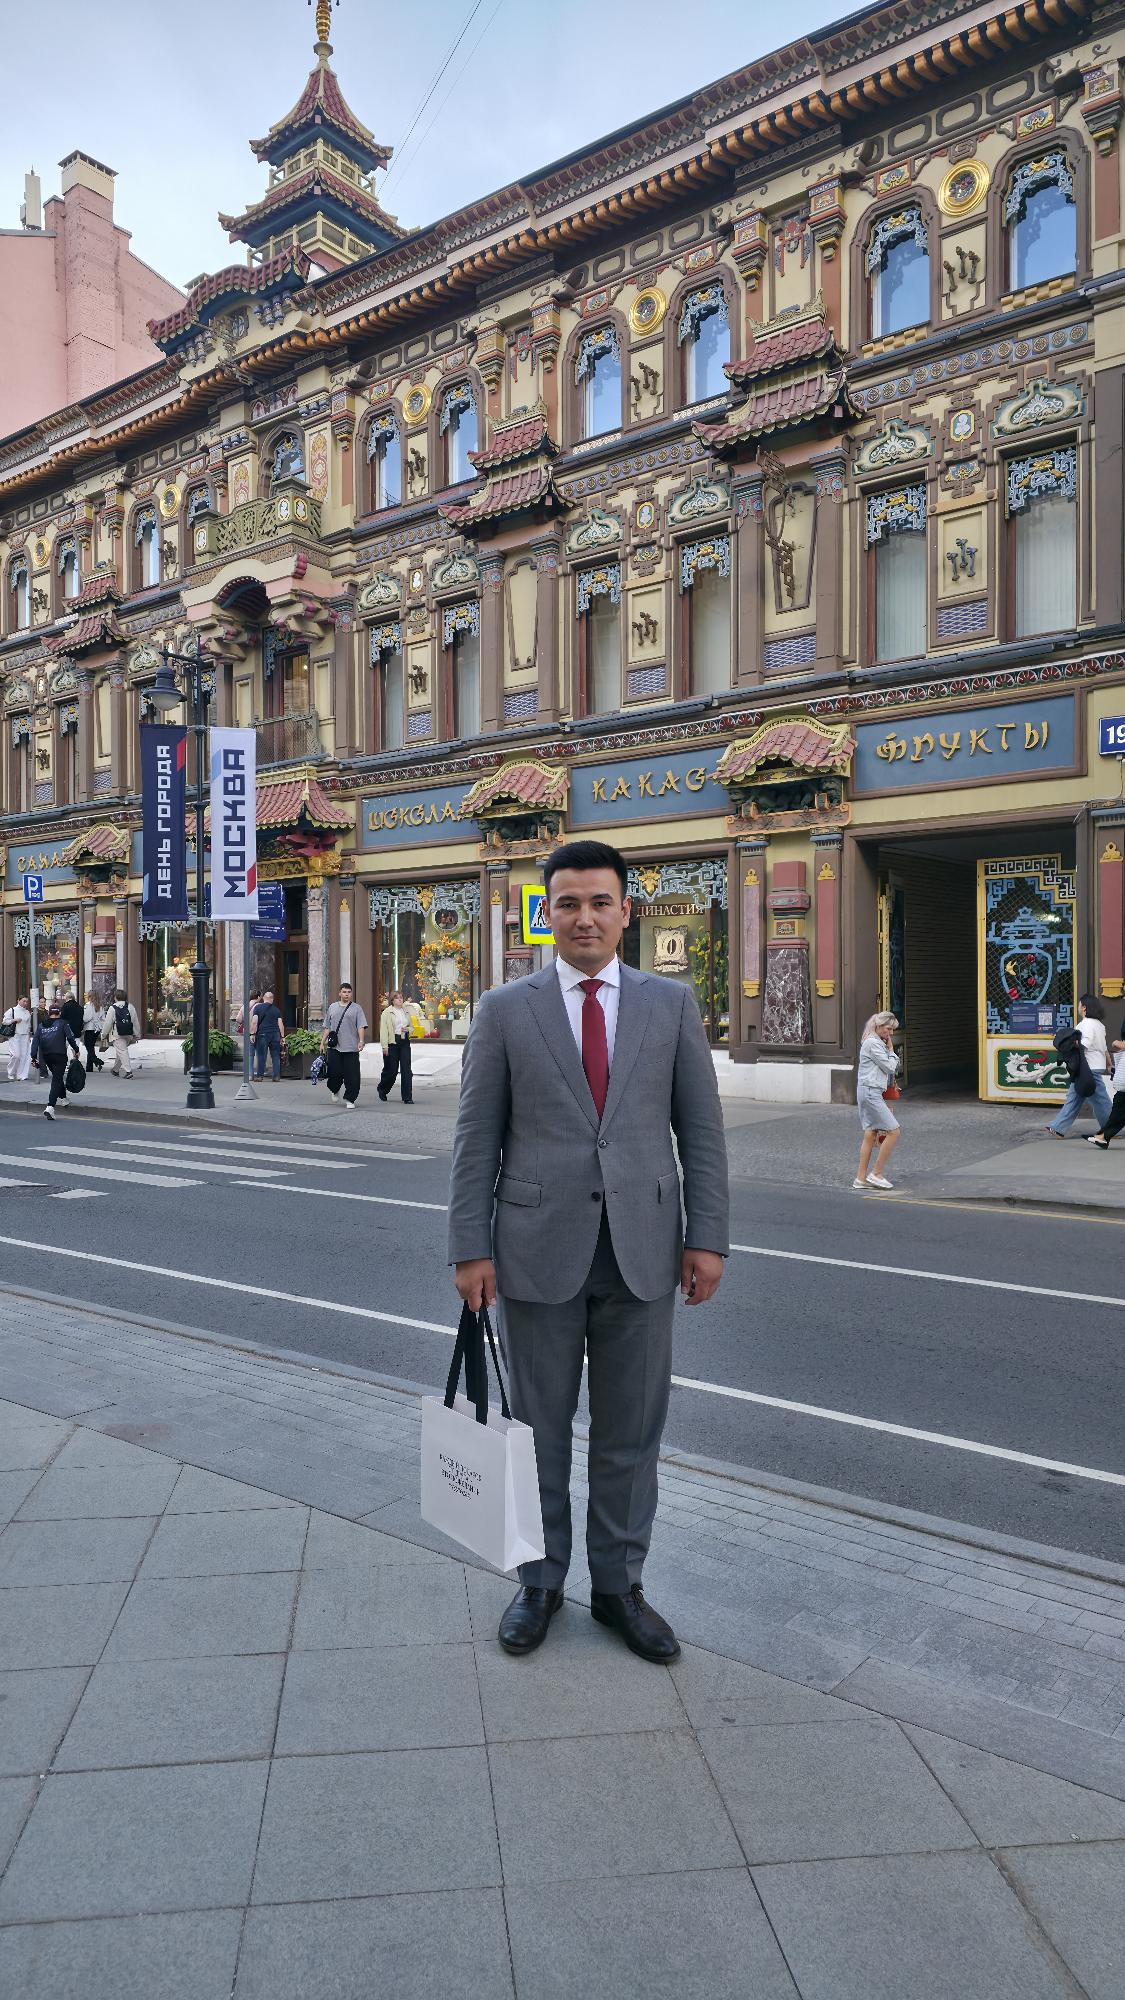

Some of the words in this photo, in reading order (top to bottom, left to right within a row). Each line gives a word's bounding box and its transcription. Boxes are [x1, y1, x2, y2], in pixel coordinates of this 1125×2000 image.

[877, 720, 1048, 763] ФРУКТЫ
[156, 745, 172, 832] ГОРОДА
[591, 766, 707, 803] КАКАО
[223, 748, 246, 898] МОСКВА
[368, 799, 463, 831] ШОКОЛА
[17, 851, 63, 872] САХА
[157, 838, 171, 899] ДЕНЬ
[637, 903, 704, 918] ДИНАСТИЯ
